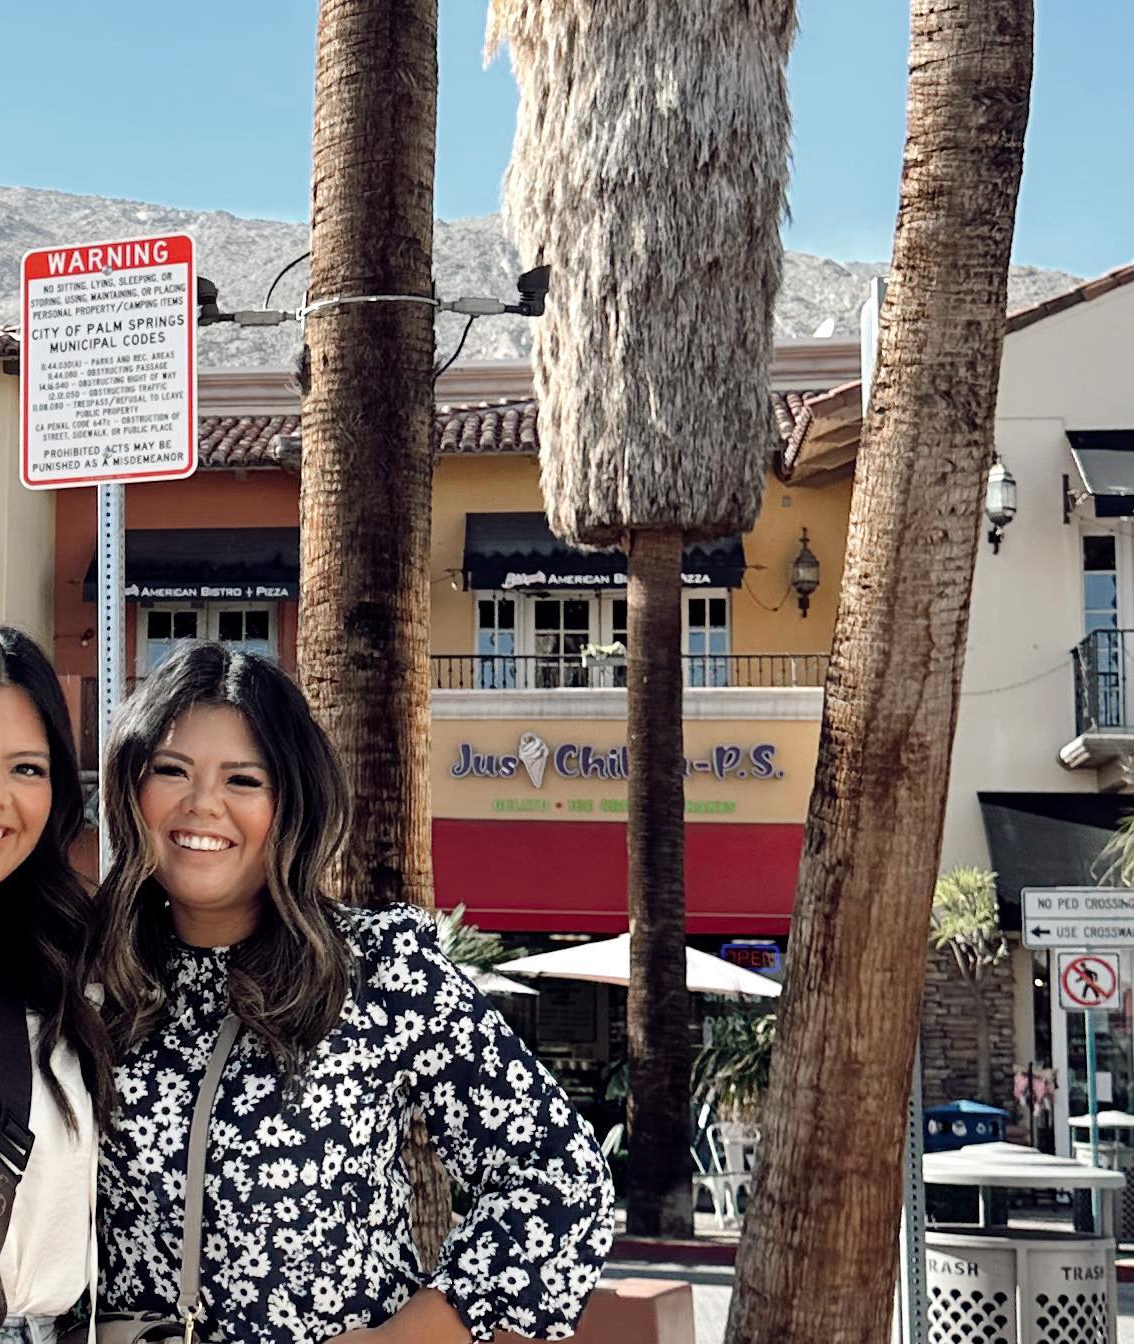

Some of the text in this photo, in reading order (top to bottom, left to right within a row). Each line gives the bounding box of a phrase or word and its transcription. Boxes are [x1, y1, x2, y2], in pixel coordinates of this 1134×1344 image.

[48, 241, 168, 275] WARNING
[43, 285, 53, 294] NO
[161, 271, 171, 281] OR
[142, 286, 151, 296] OR
[153, 283, 185, 295] PLACING
[32, 307, 72, 320] PERSONAL
[160, 296, 183, 307] ITEMS
[32, 314, 184, 340] CITY OF PALM SPRINGS
[49, 331, 165, 353] MUNICIPAL CODES
[91, 357, 113, 366] PARKS
[116, 355, 130, 363] AND
[151, 351, 174, 360] AREAS
[86, 365, 133, 376] OBSTRUCTING
[136, 362, 167, 372] PASSAGE
[78, 376, 124, 387] OBSTRUCTING
[127, 374, 146, 383] RIGHT
[149, 373, 157, 381] OF
[162, 371, 176, 379] WAY
[88, 385, 135, 396] OBSTRUCTING
[139, 382, 167, 392] TRAFFIC
[73, 394, 146, 408] TRESPASS/REFUSAL
[150, 393, 158, 401] TO
[161, 391, 183, 400] LEAVE
[75, 406, 138, 417] PUBLIC PROPERTY
[35, 423, 44, 431] CA
[47, 421, 69, 430] PENAL
[72, 420, 88, 428] CODE
[121, 413, 168, 424] OBSTRUCTION
[172, 412, 180, 420] OF
[111, 427, 120, 435] OR
[123, 425, 147, 434] PUBLIC
[150, 423, 172, 432] PLACE
[43, 439, 171, 458] PROHIBITED ACTS MAY BE
[32, 452, 183, 472] PUNISHED AS A MISDEMEANOR
[1038, 898, 1052, 909] NO
[1058, 898, 1079, 909] PED
[1056, 926, 1077, 937] USE
[928, 1259, 979, 1277] RASH
